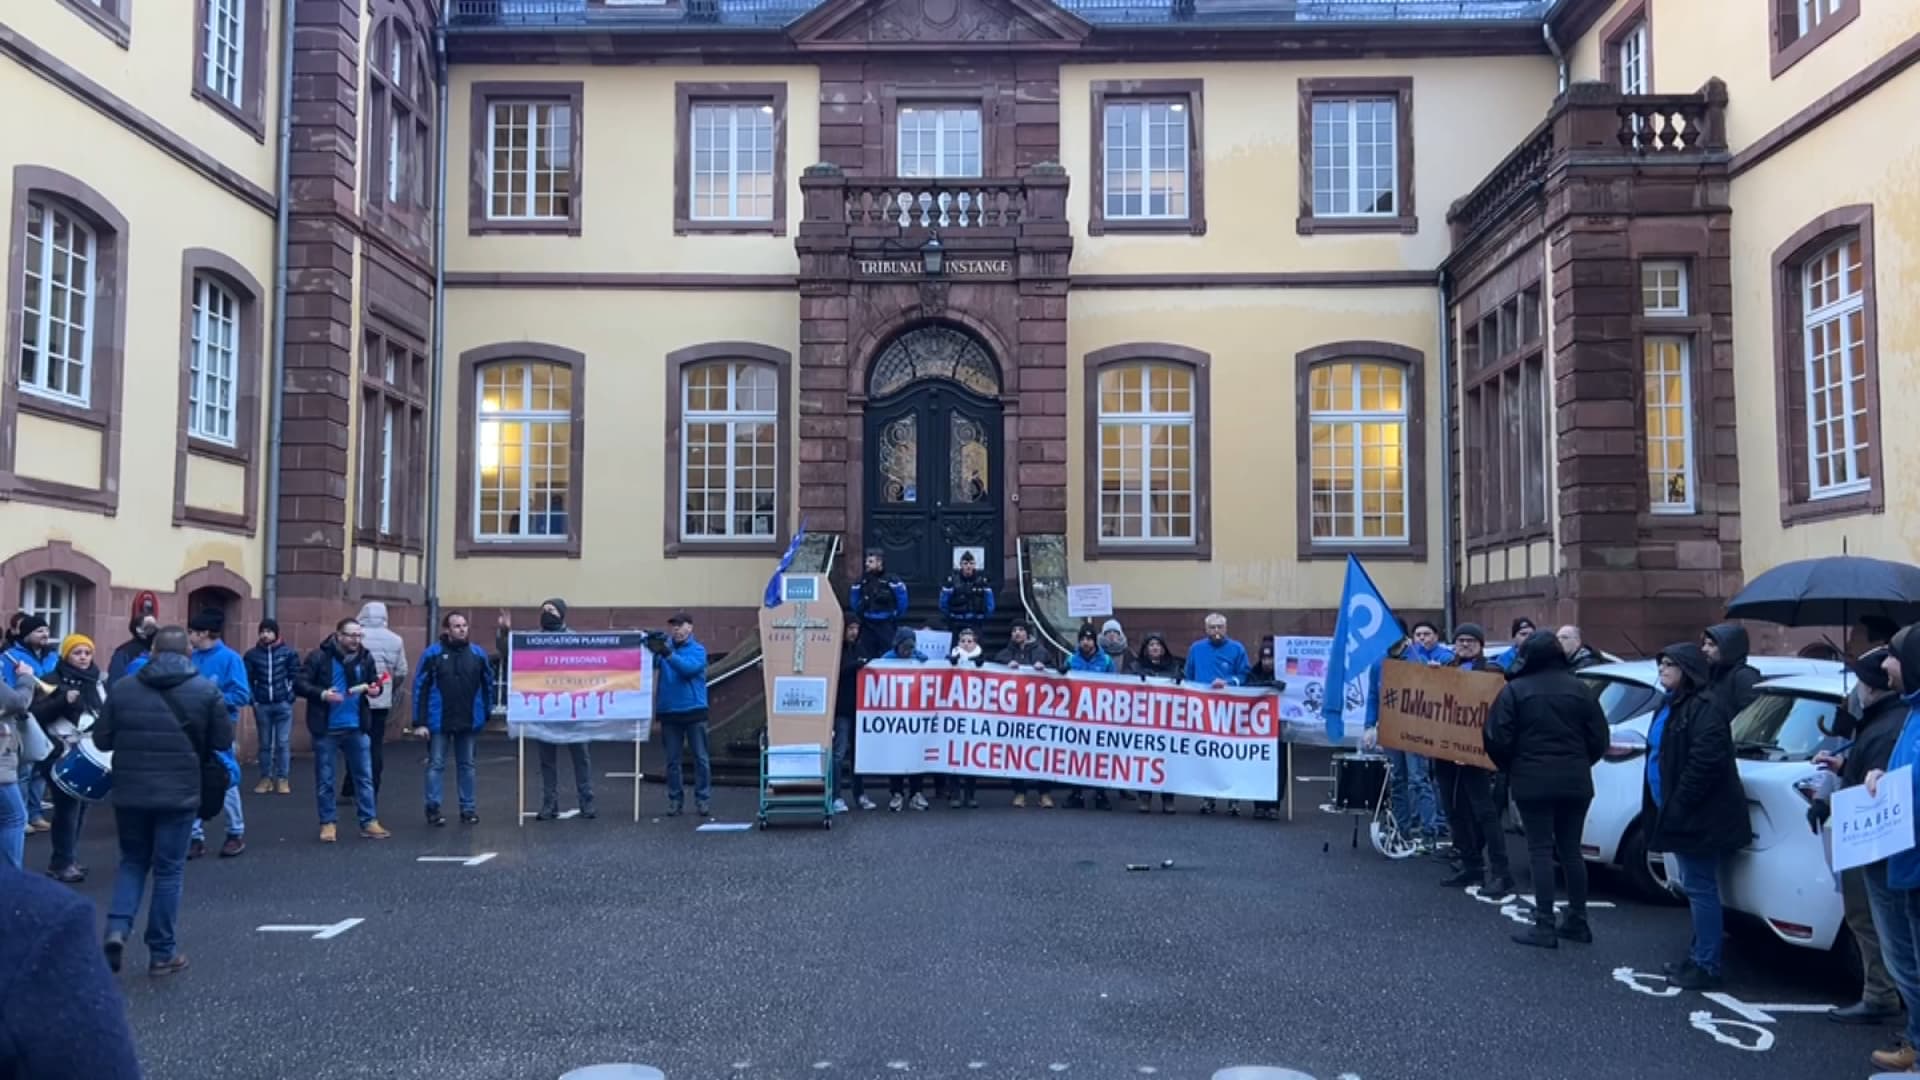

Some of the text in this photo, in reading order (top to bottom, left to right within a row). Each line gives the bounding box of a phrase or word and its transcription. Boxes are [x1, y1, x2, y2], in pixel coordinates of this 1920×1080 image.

[860, 260, 1009, 274] TRIBUNAL INSTANCE
[863, 674, 1271, 736] MIT FLABEG 122 ARBEITER WEG
[862, 713, 1271, 761] LOYAUTÉ DE LA DIRECTION ENVERS LE GROUPE
[924, 740, 1166, 784] = LICENCIEMENTS
[1842, 803, 1901, 833] FLABEG
